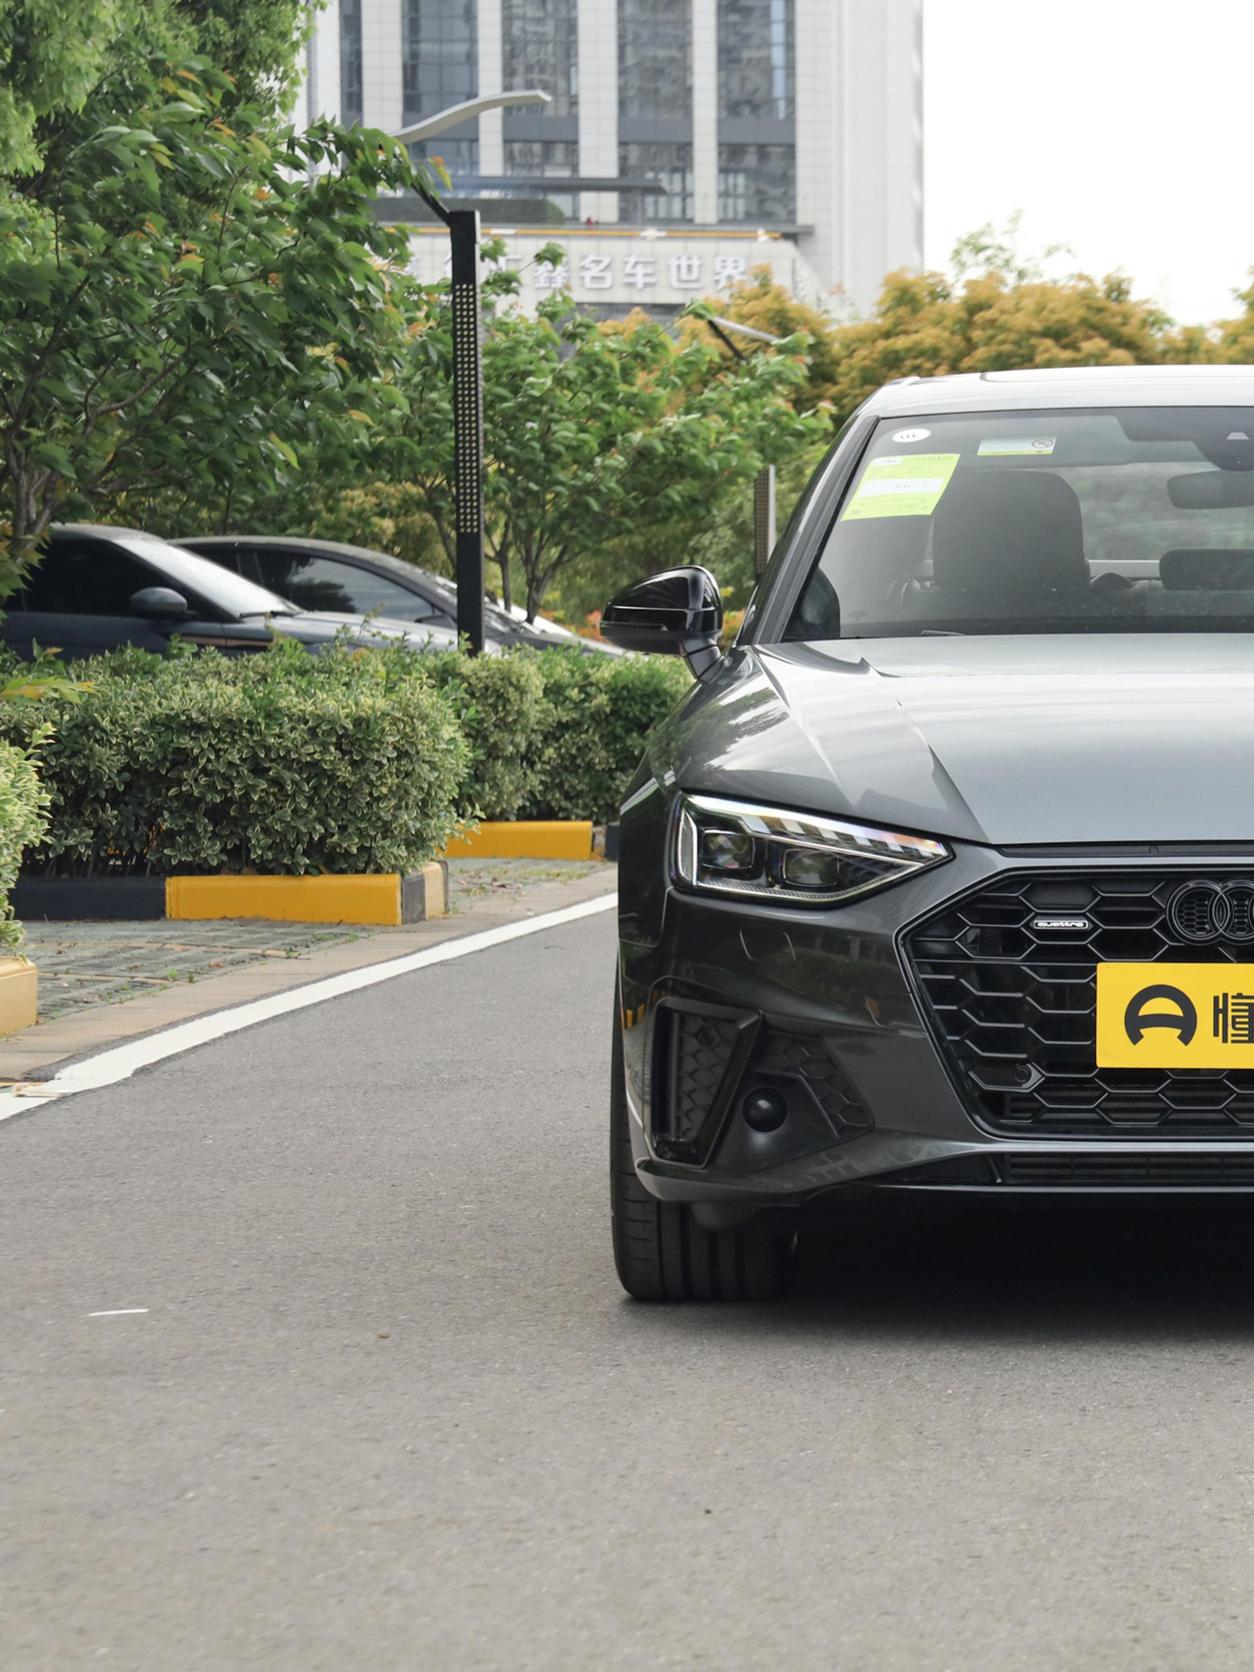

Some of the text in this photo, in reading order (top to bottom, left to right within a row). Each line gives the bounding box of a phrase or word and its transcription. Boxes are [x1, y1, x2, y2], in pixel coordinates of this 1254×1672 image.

[403, 254, 748, 291] 鑫名车世界
[1036, 920, 1085, 928] quattro
